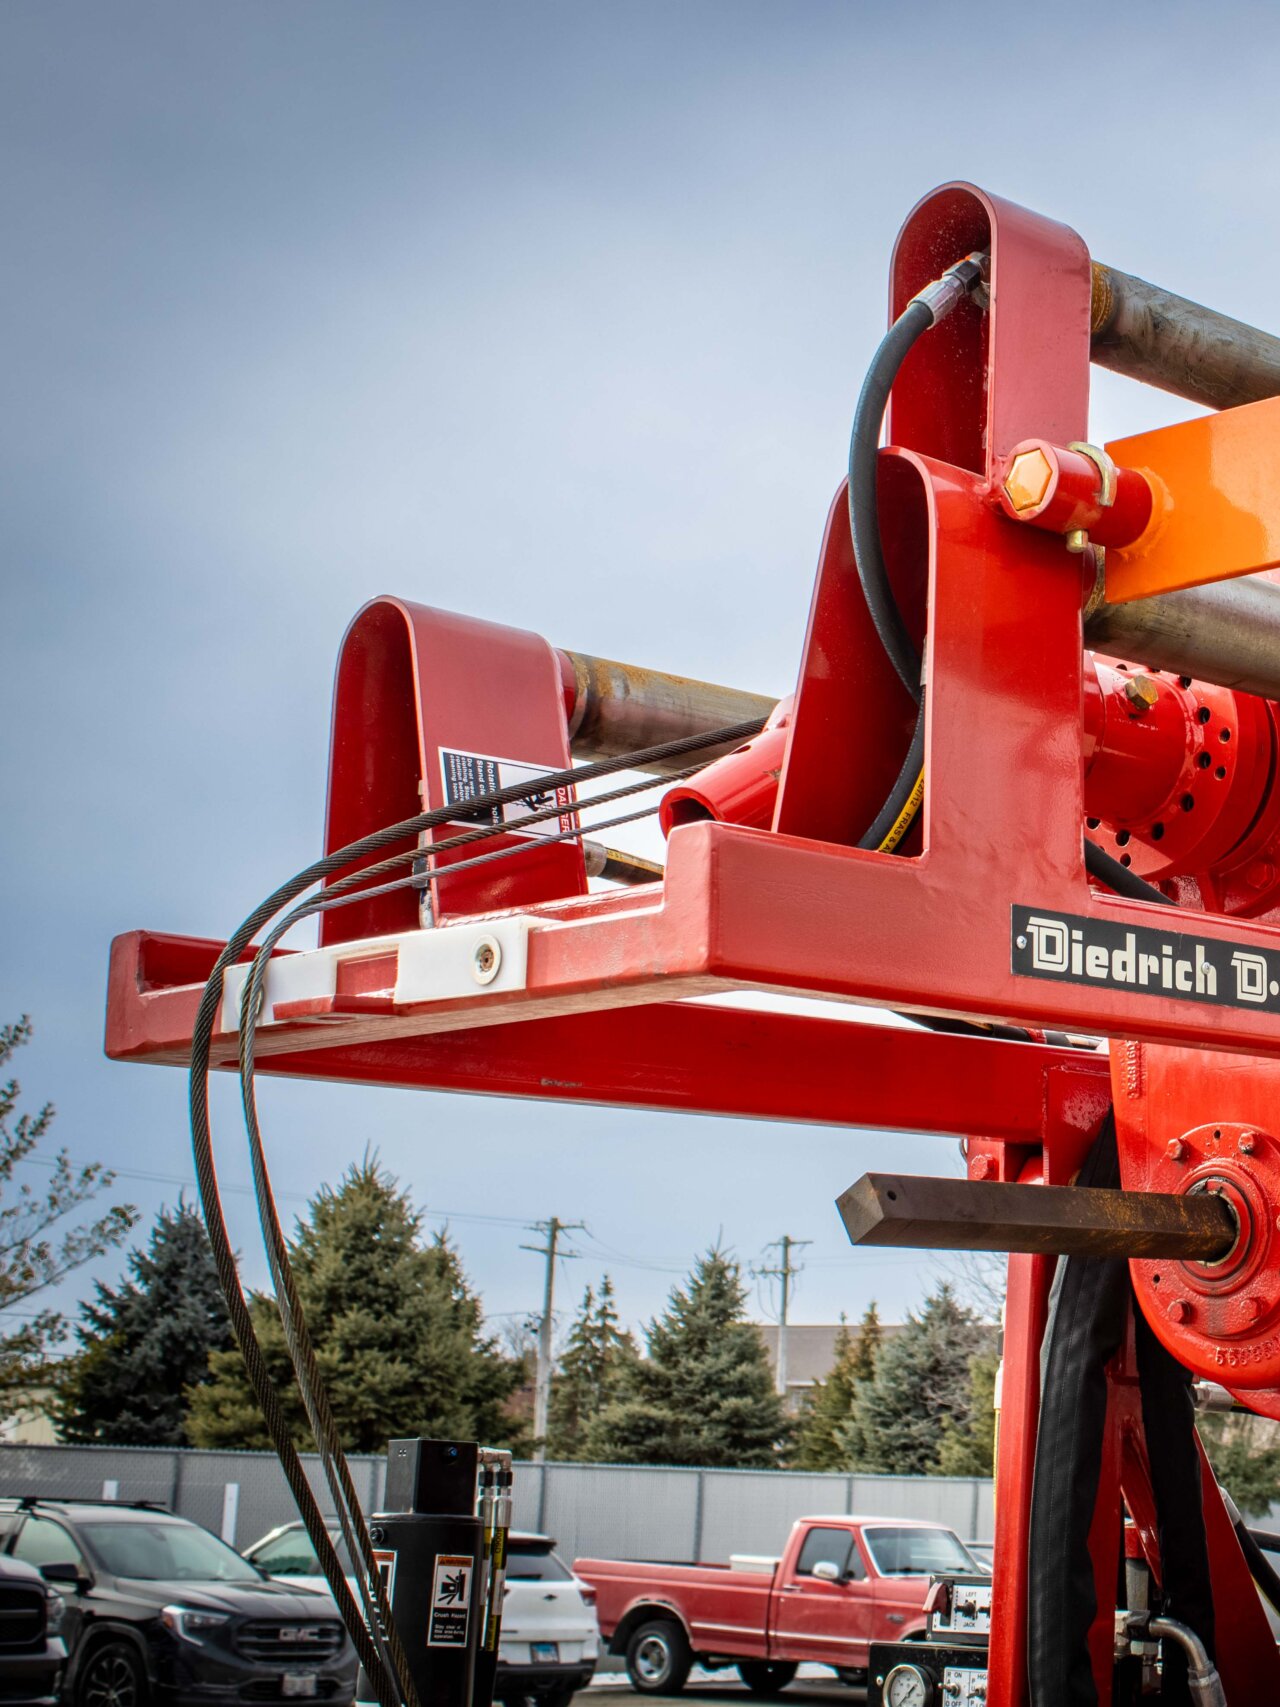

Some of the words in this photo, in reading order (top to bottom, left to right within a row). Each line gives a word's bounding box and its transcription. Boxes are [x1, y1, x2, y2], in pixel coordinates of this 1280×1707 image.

[467, 758, 473, 767] Do
[477, 760, 485, 783] Stand
[487, 761, 496, 793] Rotatin
[894, 811, 911, 836] FRAS
[1026, 915, 1218, 997] Diedrich
